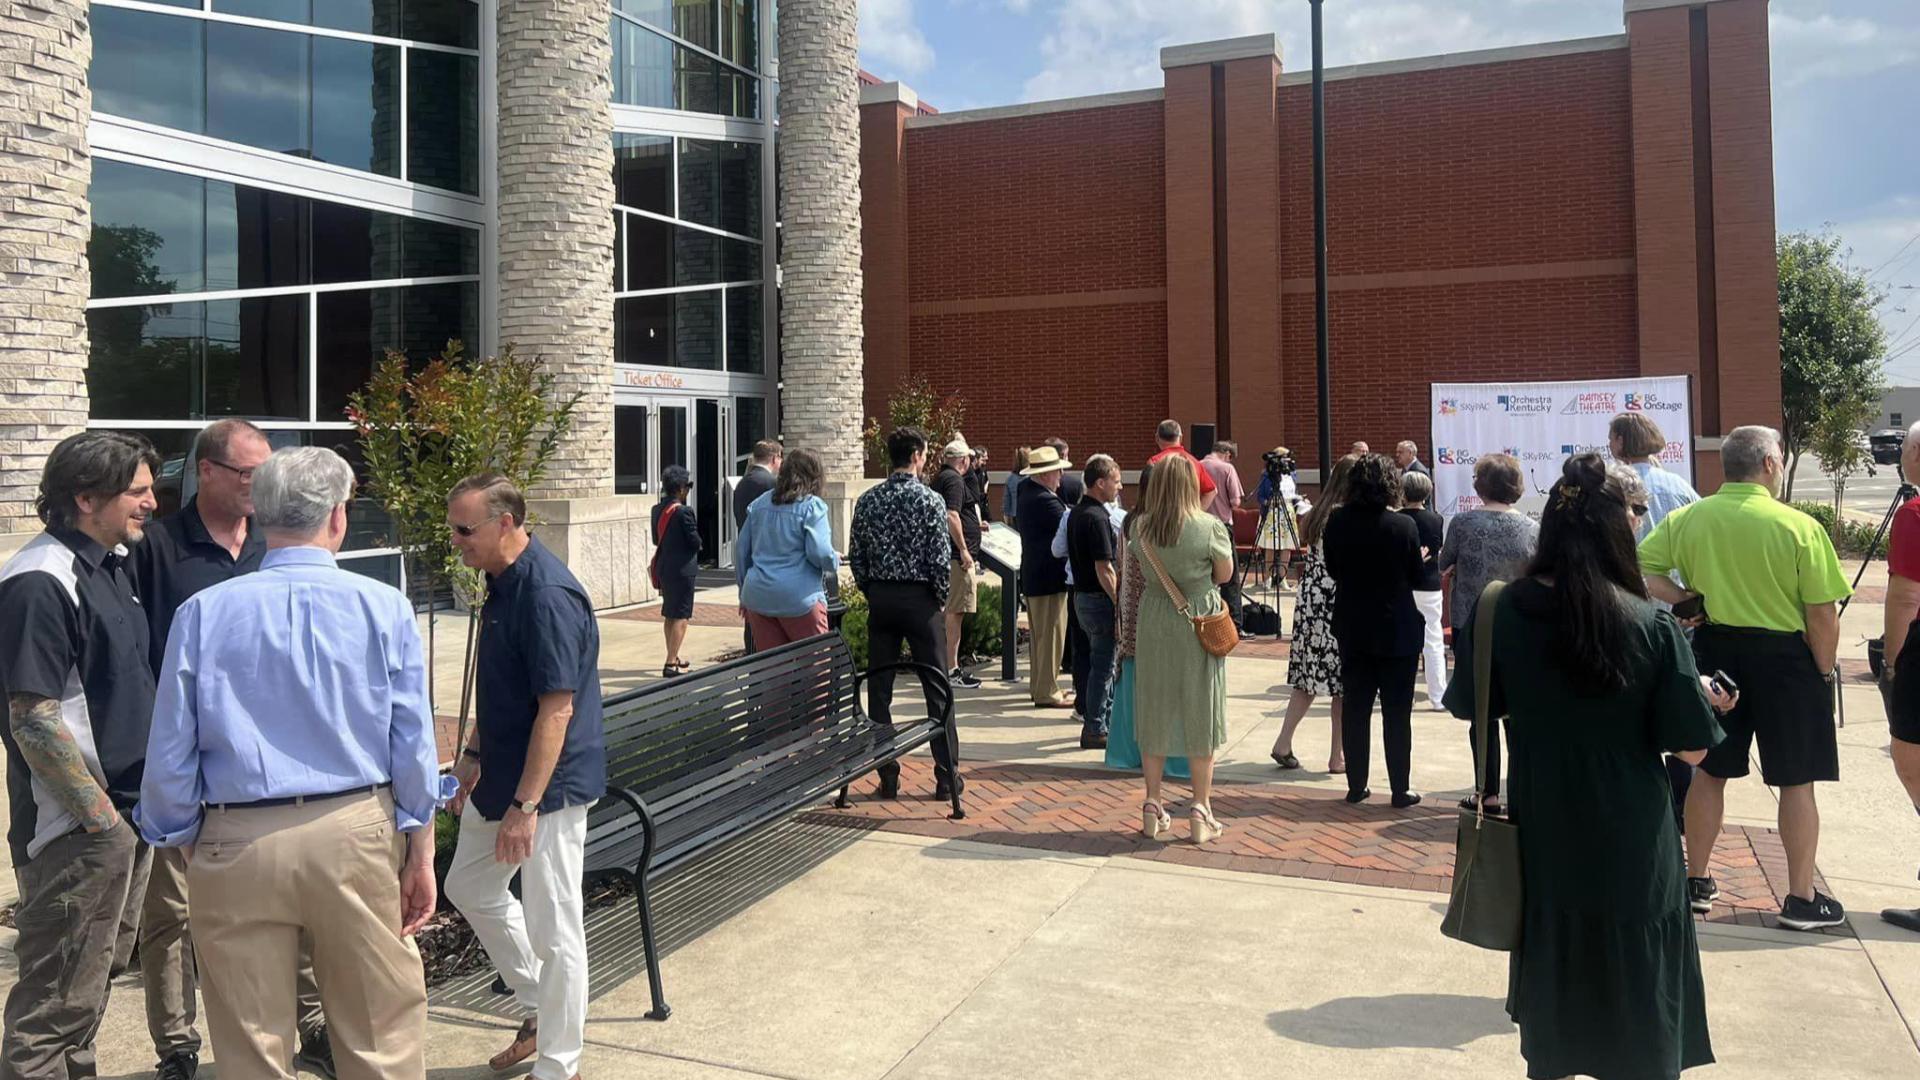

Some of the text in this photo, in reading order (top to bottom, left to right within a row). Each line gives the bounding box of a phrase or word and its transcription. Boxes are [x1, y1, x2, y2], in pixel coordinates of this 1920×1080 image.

[624, 371, 682, 387] Ticket Office
[1510, 395, 1552, 404] Orchestra
[1579, 393, 1616, 402] RAMSEY
[1510, 403, 1552, 413] Kentucky
[1580, 402, 1616, 411] THEATRE
[1644, 402, 1682, 412] OnStage
[1664, 440, 1683, 451] SEY
[1457, 449, 1469, 457] BG
